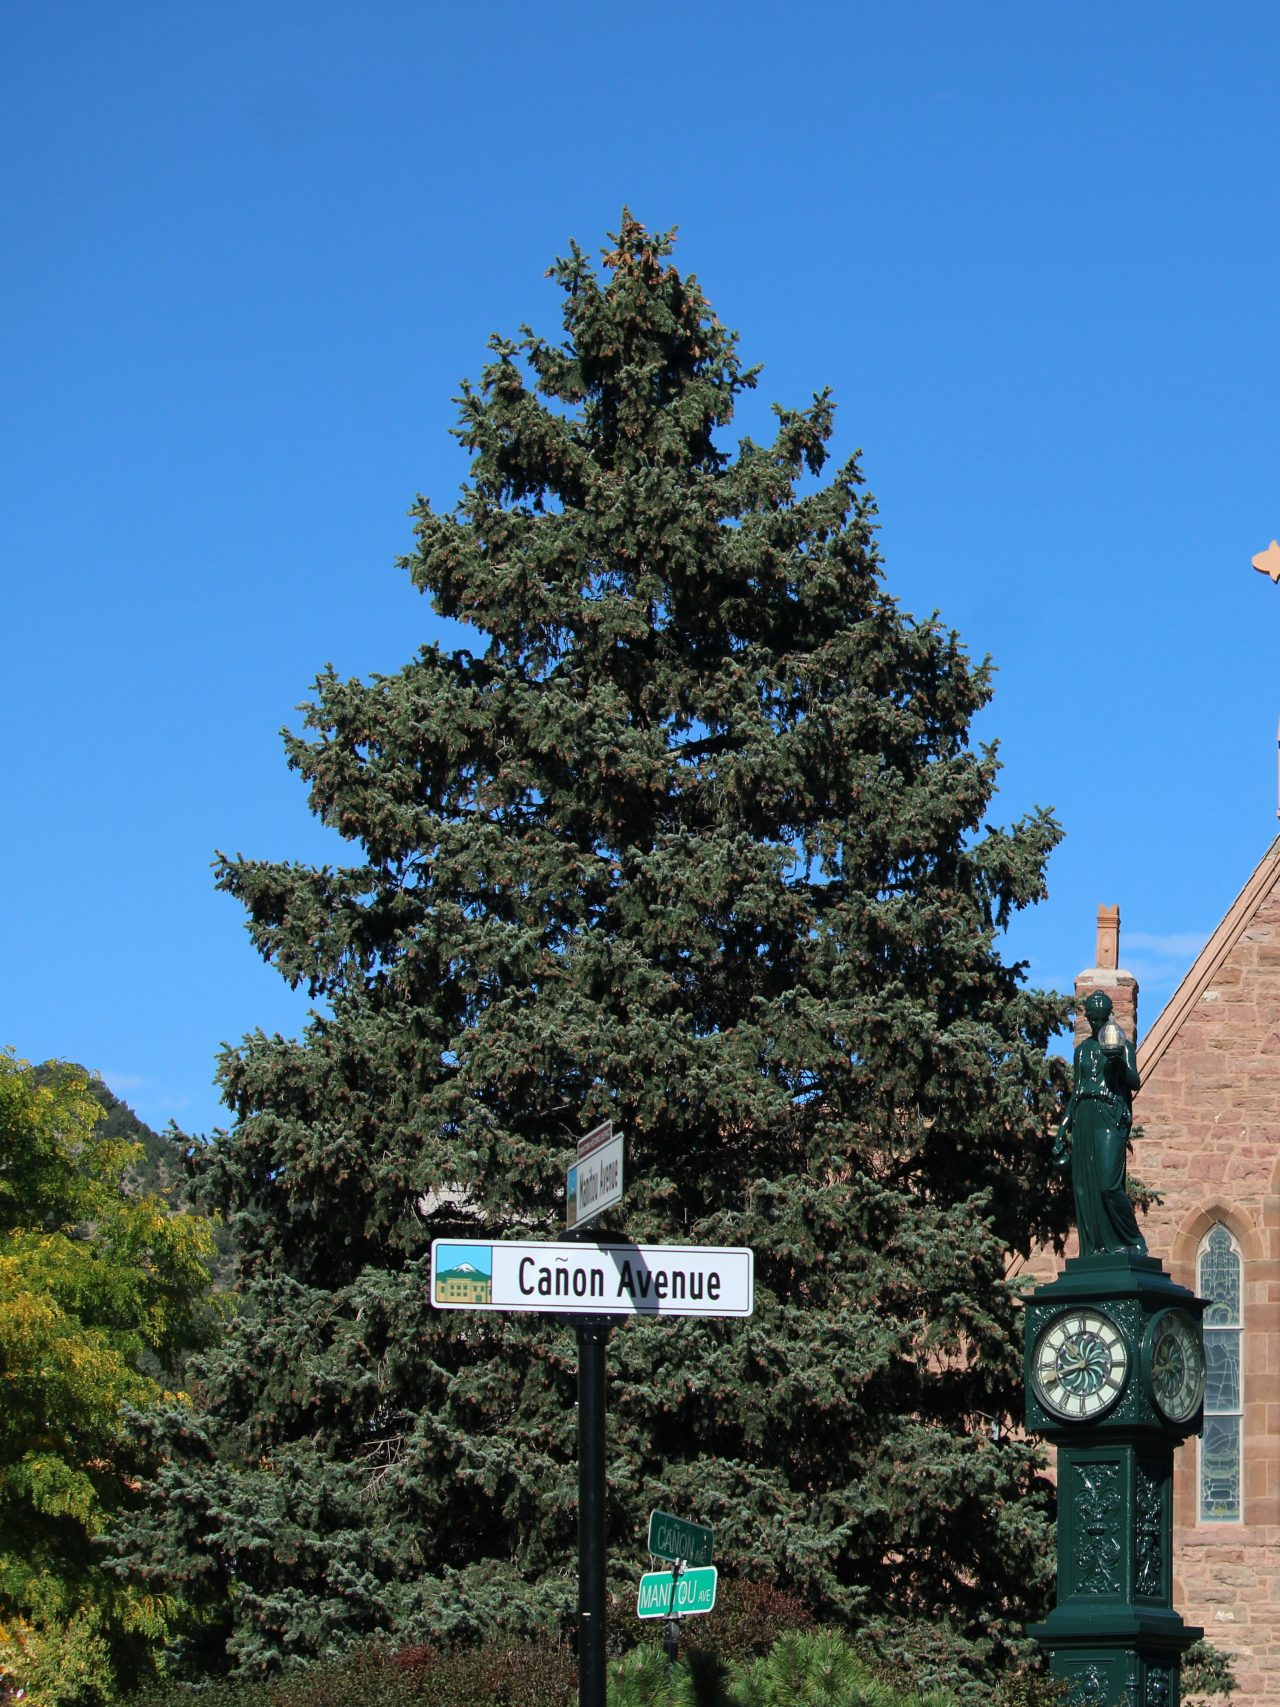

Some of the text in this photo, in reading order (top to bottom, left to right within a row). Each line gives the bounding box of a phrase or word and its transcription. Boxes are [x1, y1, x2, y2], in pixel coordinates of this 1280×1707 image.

[599, 1159, 618, 1197] Avenue
[519, 1256, 721, 1300] Cañon Avenue
[657, 1523, 695, 1558] CAÑON
[640, 1580, 711, 1609] MANITOU AVE
